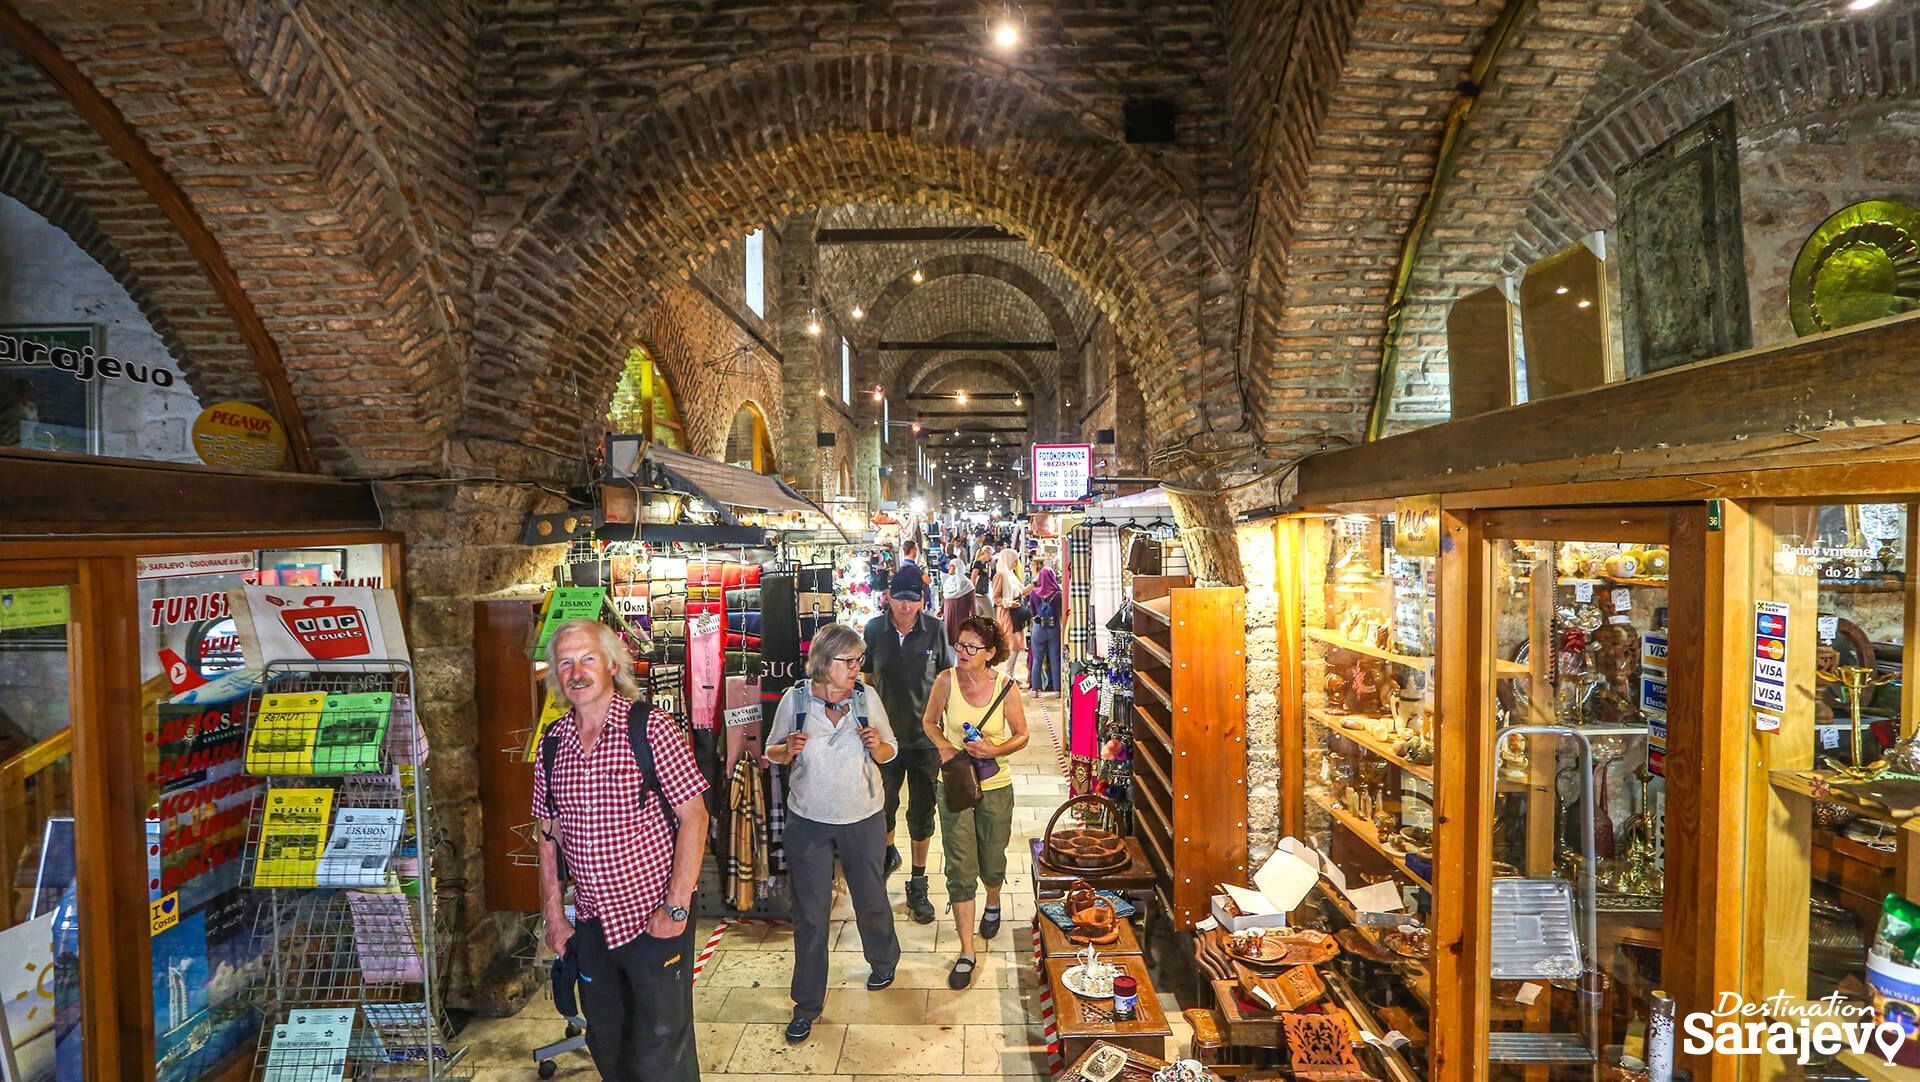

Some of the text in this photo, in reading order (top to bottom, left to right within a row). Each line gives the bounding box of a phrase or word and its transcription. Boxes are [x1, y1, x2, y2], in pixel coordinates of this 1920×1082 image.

[210, 410, 272, 433] PEGASUS
[1039, 451, 1085, 460] FOTOKOPIRNICA
[1063, 490, 1078, 498] 0.50
[1708, 516, 1718, 526] 36
[1782, 543, 1871, 559] Radno vrijeme
[149, 562, 185, 570] SARAJEVO
[190, 559, 228, 568] OSIGURANJE
[1825, 567, 1841, 577] do
[150, 591, 230, 628] TURIST
[297, 616, 356, 631] VIP
[303, 630, 362, 642] travels
[1758, 662, 1783, 678] VISA
[1758, 686, 1782, 702] VISA
[264, 712, 300, 722] BEIRUT
[1653, 727, 1666, 738] VIS
[345, 825, 388, 835] LISABON
[152, 904, 161, 920] I
[153, 914, 176, 931] Costa
